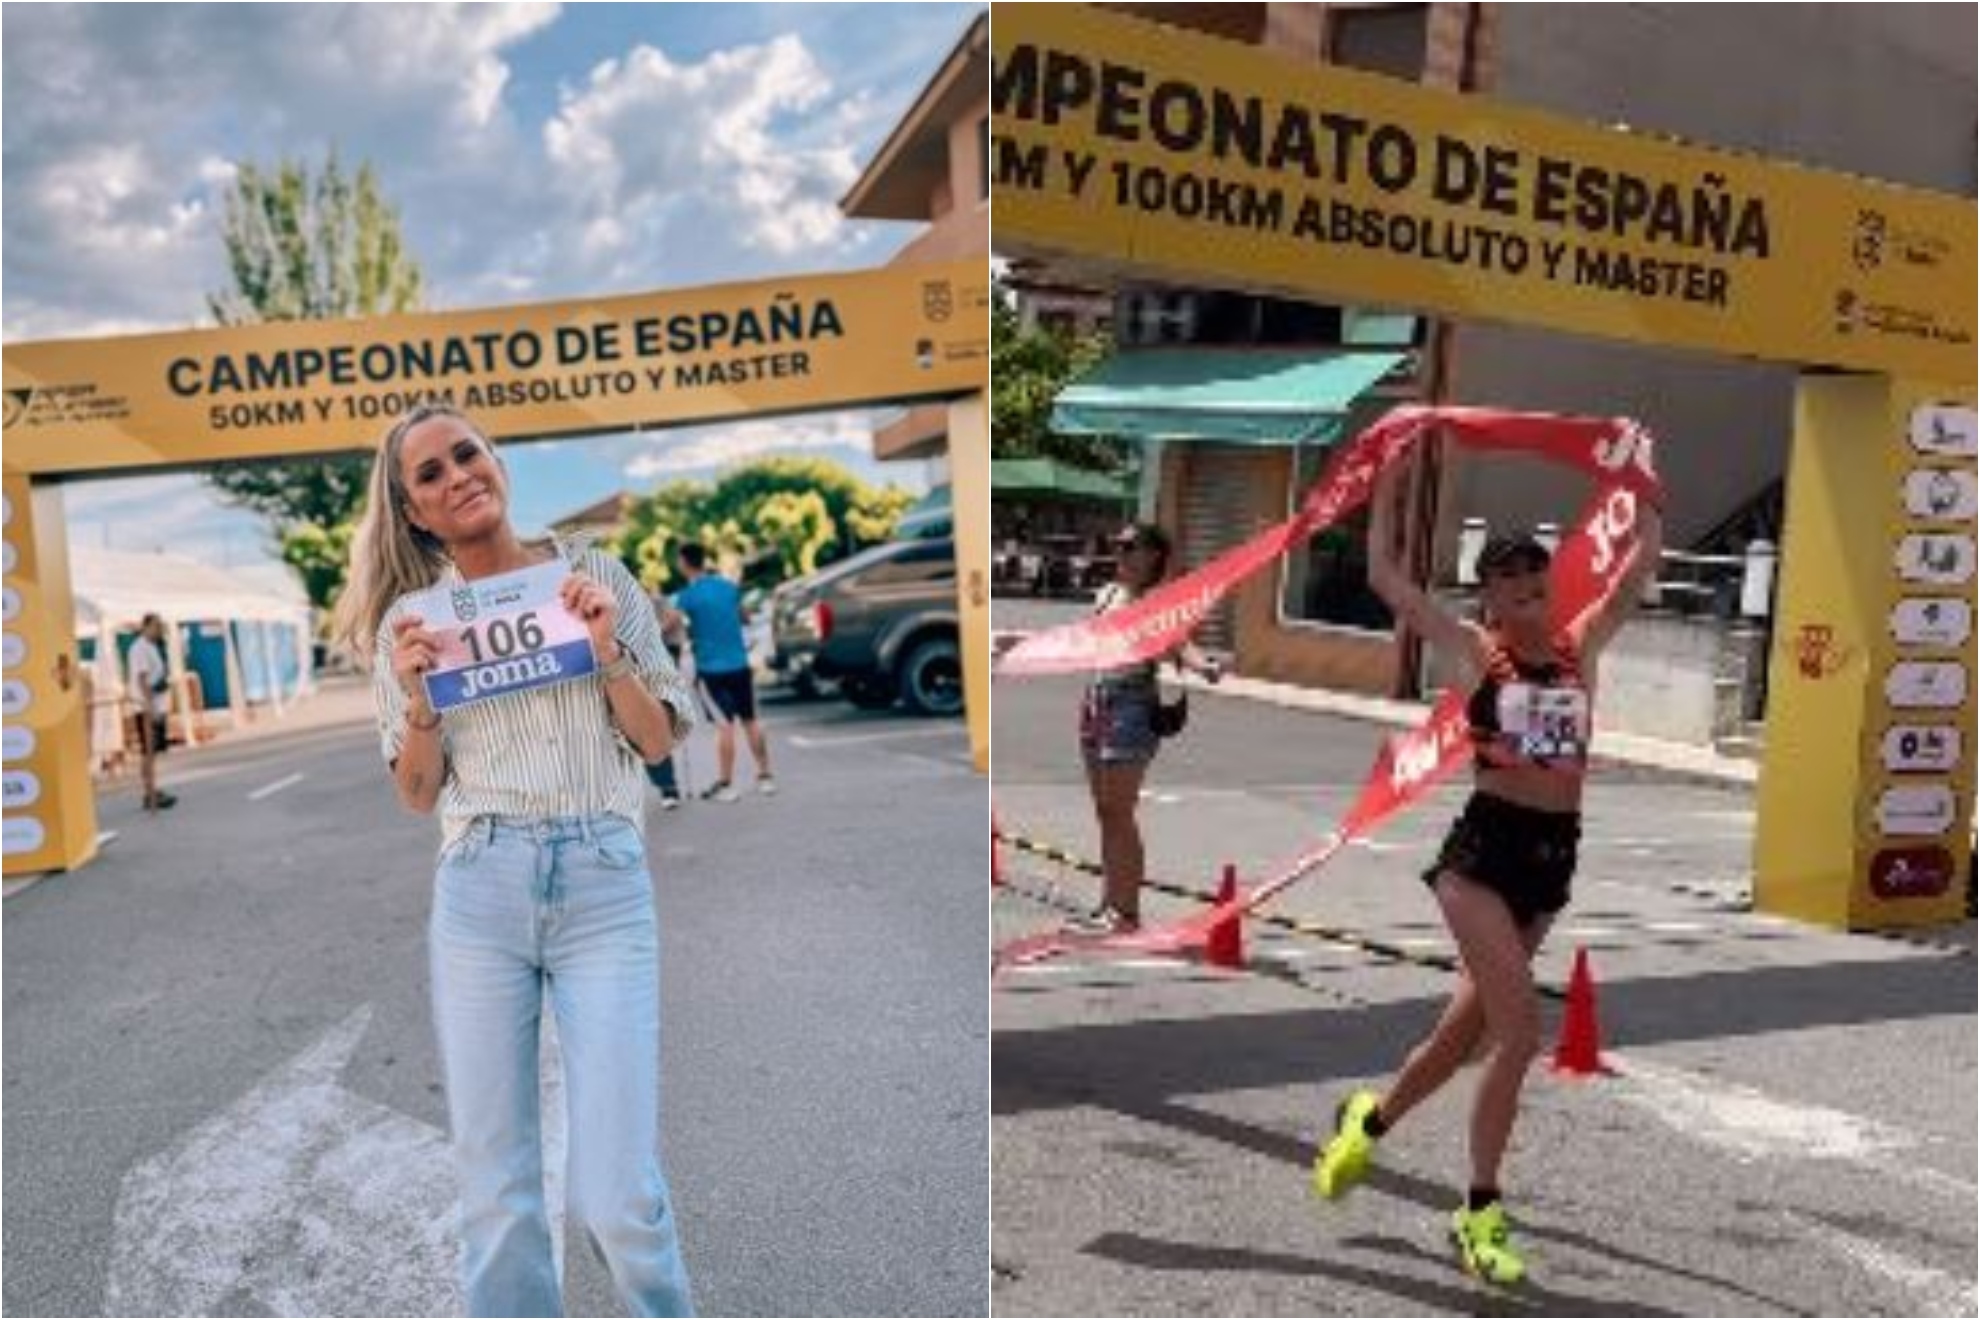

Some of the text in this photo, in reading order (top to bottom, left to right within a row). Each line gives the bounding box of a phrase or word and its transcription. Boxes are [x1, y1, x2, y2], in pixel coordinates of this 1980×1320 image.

[1064, 150, 1097, 195] Y
[1112, 161, 1283, 230] 100KM
[1293, 197, 1529, 275] ABSOLUTO
[1541, 242, 1566, 280] Y
[1574, 248, 1728, 305] MASTER
[1434, 135, 1519, 215] DE
[1534, 155, 1770, 258] ESPAÑA
[167, 292, 844, 397] CAMPEONATO DE ESPAÑA
[210, 402, 306, 430] 50KM
[312, 398, 335, 422] Y
[463, 368, 637, 408] ABSOLUTO
[646, 366, 667, 391] Y
[675, 350, 811, 388] MASTER
[459, 611, 546, 662] 106
